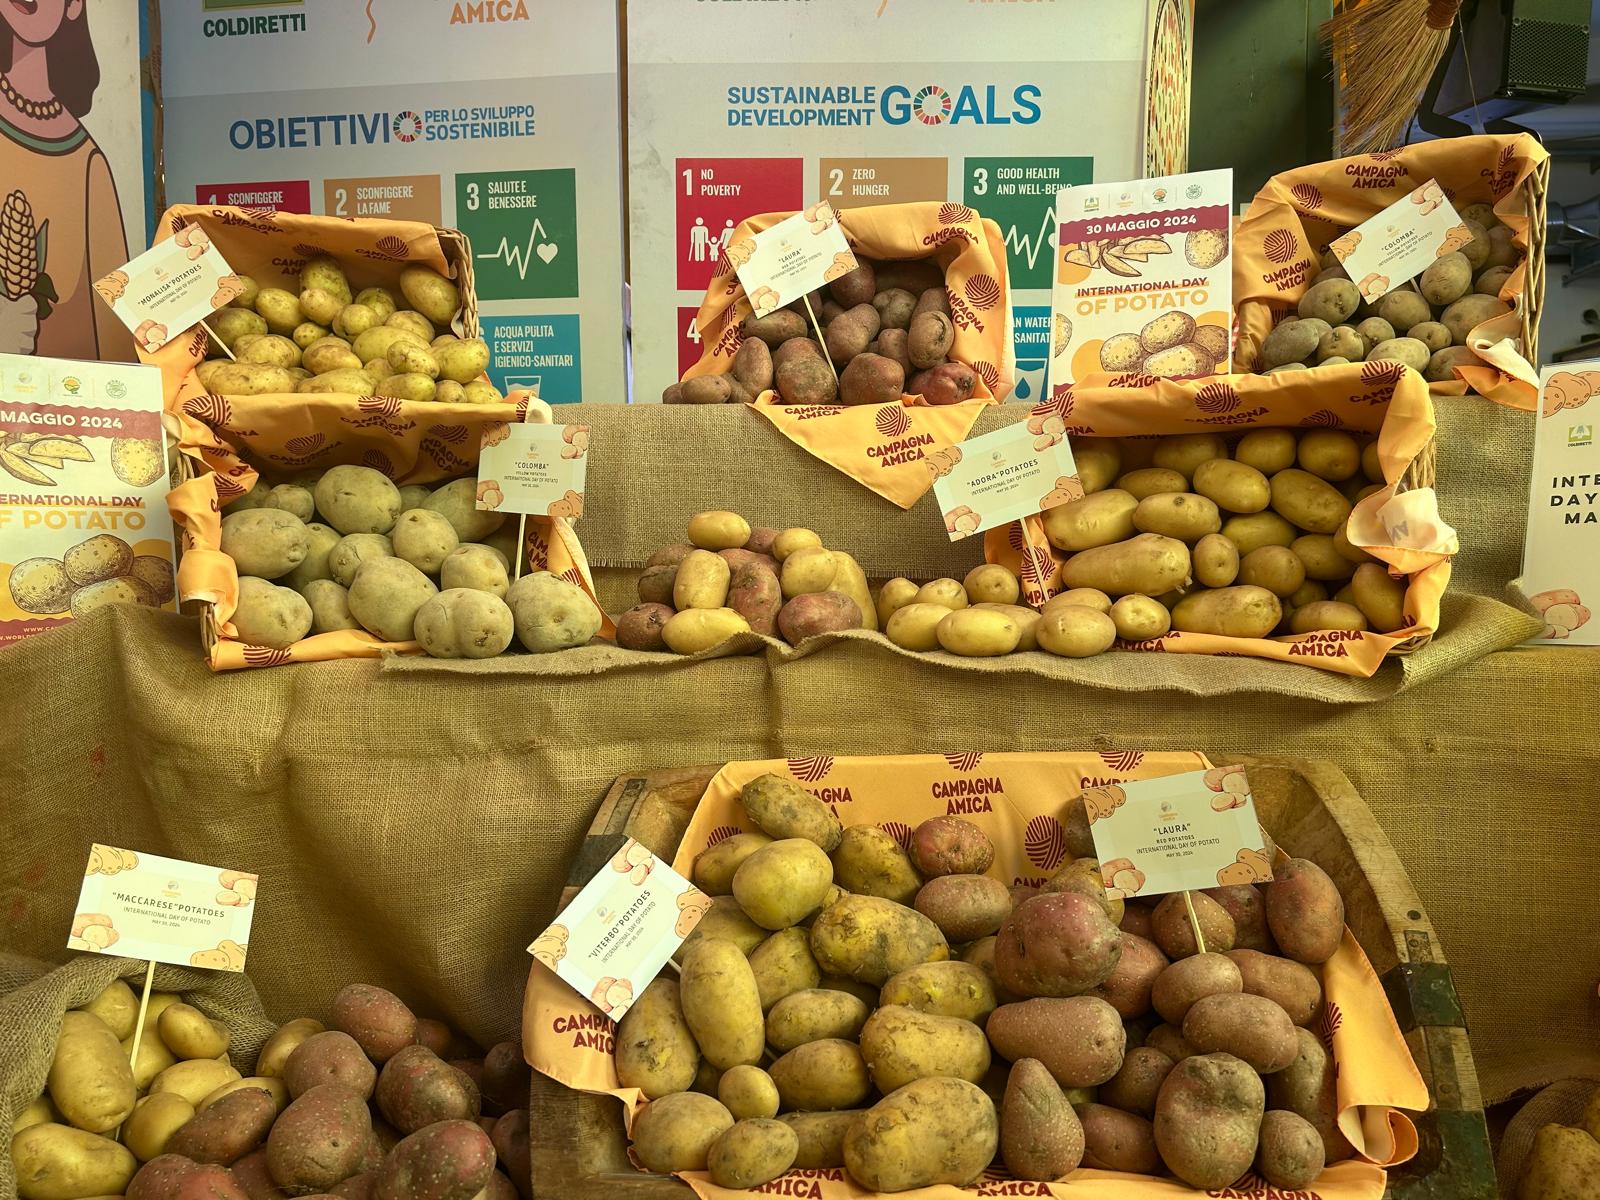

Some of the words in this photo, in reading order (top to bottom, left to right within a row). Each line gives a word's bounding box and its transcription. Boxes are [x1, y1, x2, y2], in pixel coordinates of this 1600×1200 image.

[450, 0, 529, 24] AMICA
[203, 13, 306, 37] COLDIRETTI
[727, 86, 875, 104] SUSTAINABLE
[880, 84, 1042, 125] GOALS
[425, 109, 449, 123] PER
[452, 108, 467, 121] LO
[471, 105, 535, 120] SVILUPPO
[727, 109, 875, 126] DEVELOPMENT
[229, 112, 390, 150] OBIETTIVI
[425, 120, 535, 141] SOSTENIBILE
[701, 169, 714, 180] NO
[852, 169, 875, 180] ZERO
[997, 168, 1023, 179] GOOD
[1026, 168, 1060, 179] HEALTH
[1345, 164, 1408, 177] CAMPAGNA
[488, 181, 520, 194] SALUTE
[521, 180, 527, 192] E
[682, 169, 693, 196] 1
[829, 169, 843, 196] 2
[973, 168, 988, 195] 3
[997, 184, 1016, 195] AND
[1352, 178, 1396, 188] AMICA
[228, 191, 283, 205] SCONFIGGERE
[357, 185, 414, 200] SCONFIGGERE
[466, 183, 479, 211] 3
[701, 185, 741, 196] POVERTY
[852, 185, 889, 196] HUNGER
[336, 188, 347, 215] 2
[357, 203, 370, 214] LA
[371, 202, 391, 214] FAME
[488, 195, 537, 209] BENESSERE
[1086, 225, 1102, 235] 30
[1105, 220, 1160, 233] MAGGIO
[1164, 214, 1197, 226] 2024
[923, 227, 979, 247] CAMPAGNA
[1263, 258, 1311, 283] CAMPAGNA
[1077, 280, 1178, 297] INTERNATIONAL
[1181, 277, 1208, 287] DAY
[1275, 273, 1306, 291] AMICA
[1076, 297, 1107, 316] OF
[1114, 290, 1209, 312] POTATO
[494, 326, 523, 339] ACQUA
[525, 325, 554, 337] PULITA
[687, 318, 701, 344] 4
[1014, 332, 1050, 344] SANITAT
[495, 342, 500, 353] E
[501, 341, 533, 353] SERVIZI
[495, 355, 573, 368] IGIENICO-SANITARI
[1, 411, 76, 427] MAGGIO
[80, 416, 123, 429] 2024
[797, 410, 841, 420] AMICA
[867, 433, 935, 458] CAMPAGNA
[881, 448, 926, 468] AMICA
[970, 480, 1005, 495] INTERNATIONAL
[1022, 468, 1040, 478] POTATO
[112, 496, 142, 507] DAY
[1550, 493, 1598, 507] DAY
[23, 510, 146, 530] POTATO
[1306, 630, 1364, 643] PAGNA
[1288, 643, 1348, 657] AMICA
[805, 787, 852, 803] AGNA
[932, 777, 1003, 798] CAMPAGNA
[946, 796, 992, 815] AMICA
[1153, 823, 1191, 835] "LAURA"
[1136, 843, 1177, 854] INTERNATIONAL
[1197, 837, 1219, 846] POTATO
[1168, 834, 1194, 842] POTATOES
[123, 906, 167, 918] INTERNATIONAL
[189, 917, 210, 925] POTATO
[600, 930, 630, 963] INTERNATIONAL
[627, 922, 637, 933] DAY
[634, 916, 642, 925] OF
[639, 900, 656, 918] POTATO
[573, 1031, 616, 1055] AMIC
[787, 1168, 844, 1181] AGNA
[977, 1182, 1053, 1197] AMICA
